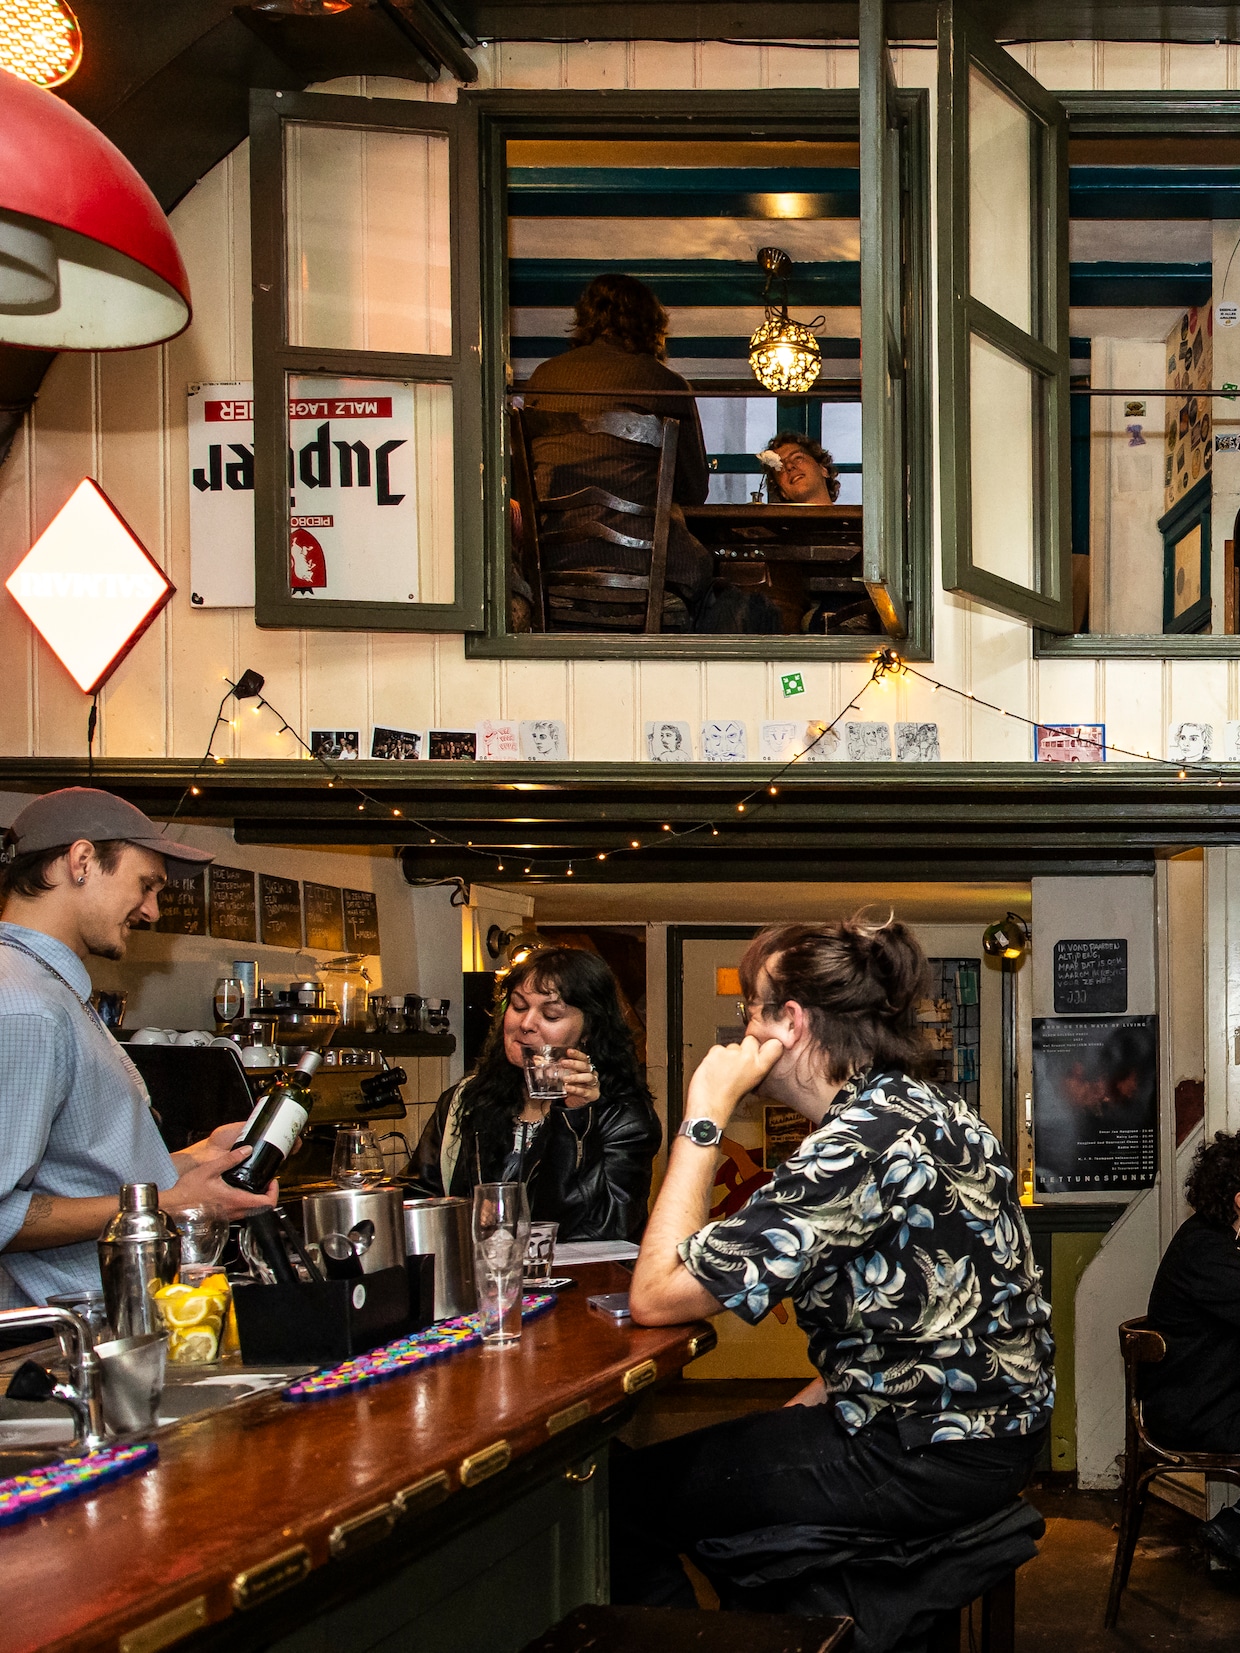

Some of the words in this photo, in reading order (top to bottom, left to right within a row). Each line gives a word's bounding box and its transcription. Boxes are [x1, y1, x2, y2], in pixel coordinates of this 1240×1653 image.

[220, 402, 253, 420] IER
[290, 402, 329, 416] LAGE
[336, 401, 378, 416] MALZ
[1058, 944, 1065, 952] IK
[1058, 961, 1078, 971] MAAR
[1081, 961, 1095, 969] DAT
[1040, 1174, 1153, 1183] RETTUNGSPUNKT
